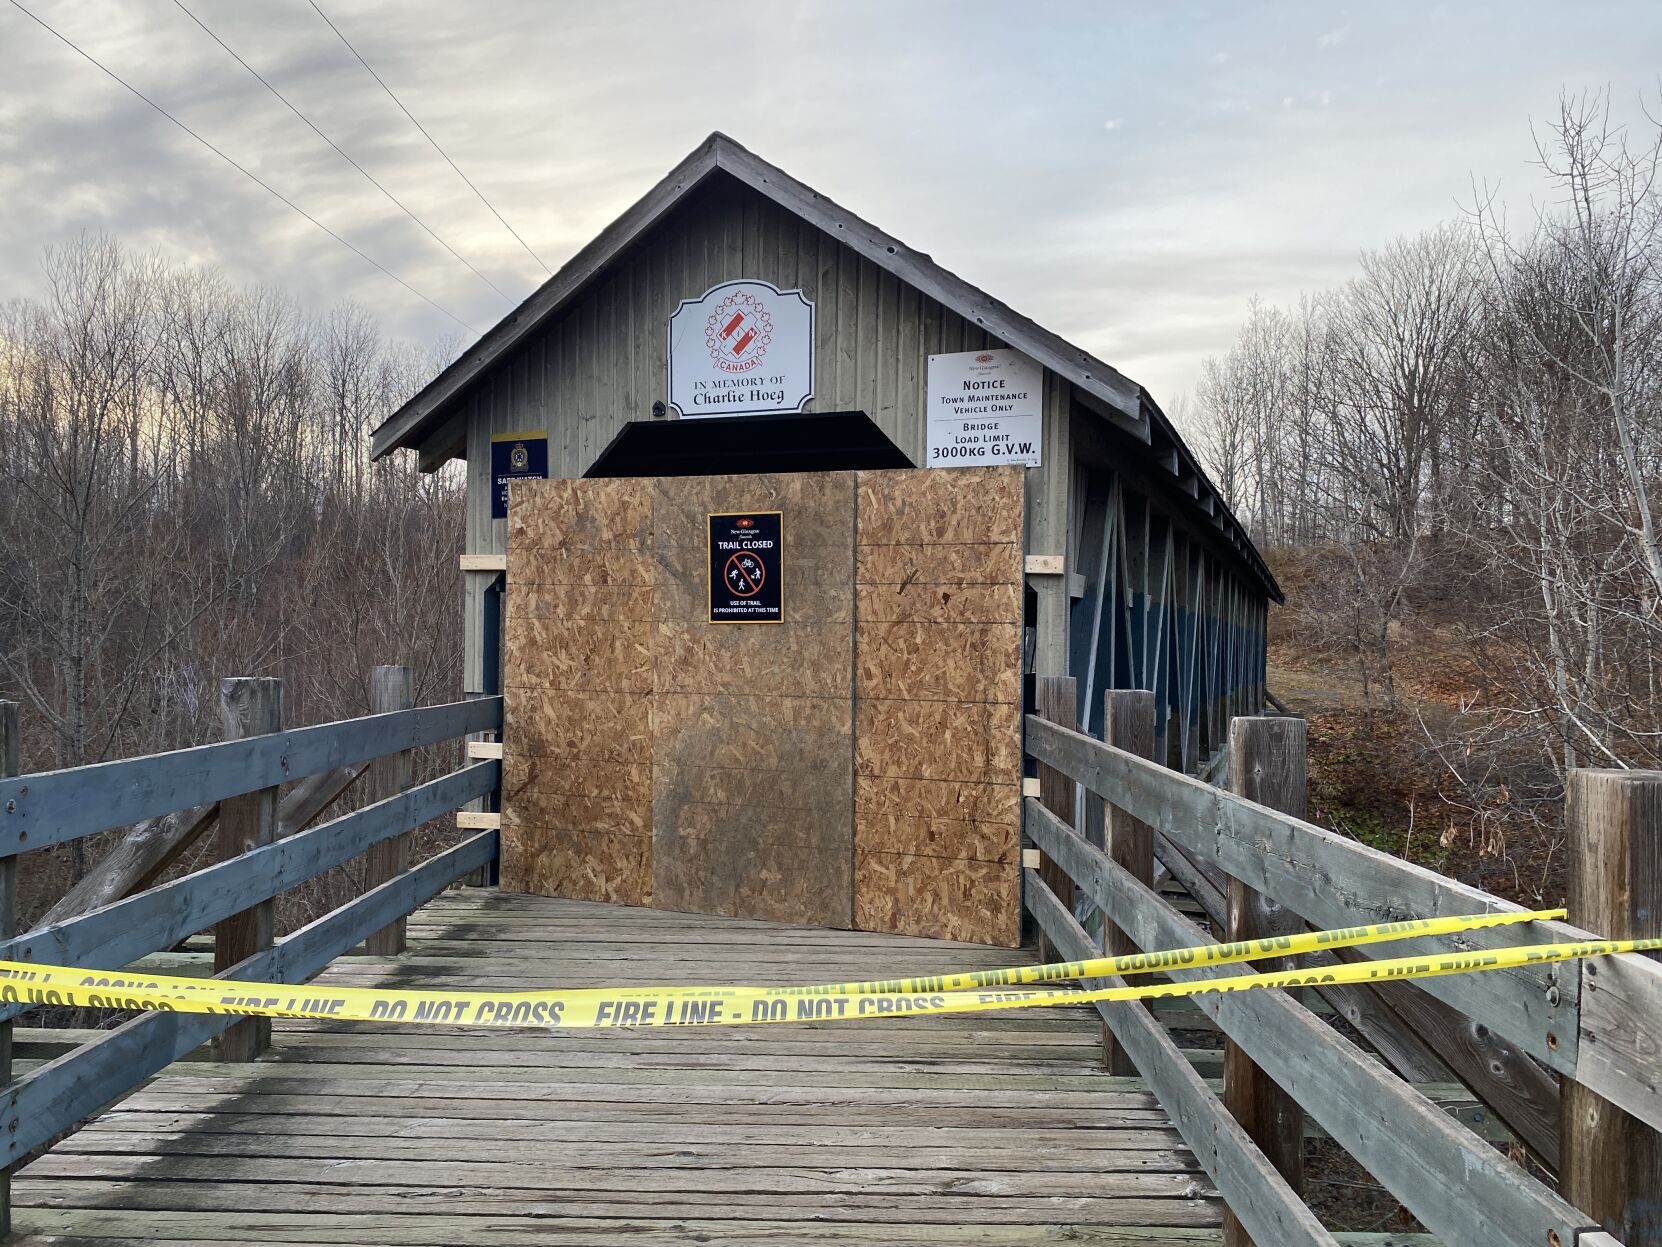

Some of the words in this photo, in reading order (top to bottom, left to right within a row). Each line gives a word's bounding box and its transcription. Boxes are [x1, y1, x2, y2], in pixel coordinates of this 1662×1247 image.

[720, 359, 757, 372] CANADA
[694, 381, 707, 390] IN
[712, 376, 766, 389] MEMORY
[770, 375, 786, 385] OF
[963, 380, 1006, 391] NOTICE
[693, 389, 746, 406] Charlie
[750, 389, 785, 404] Hoeg
[941, 396, 965, 405] TOWN
[967, 392, 1028, 403] MAINTENANCE
[954, 404, 988, 414] VEHICLE
[991, 404, 1014, 412] ONLY
[963, 422, 1000, 431] BRIDGE
[955, 435, 979, 444] LOAD
[983, 434, 1011, 442] LIMIT
[991, 442, 1036, 456] G.V.W.
[718, 541, 741, 549] TRAIL
[742, 540, 774, 549] CLOSED
[414, 1000, 471, 1023] NOT
[473, 1001, 565, 1027] CROSS
[594, 1001, 658, 1026] FIRE
[664, 1000, 724, 1025] LINE
[751, 998, 788, 1021] DO
[797, 998, 850, 1019] NOT
[858, 995, 945, 1015] CROSS
